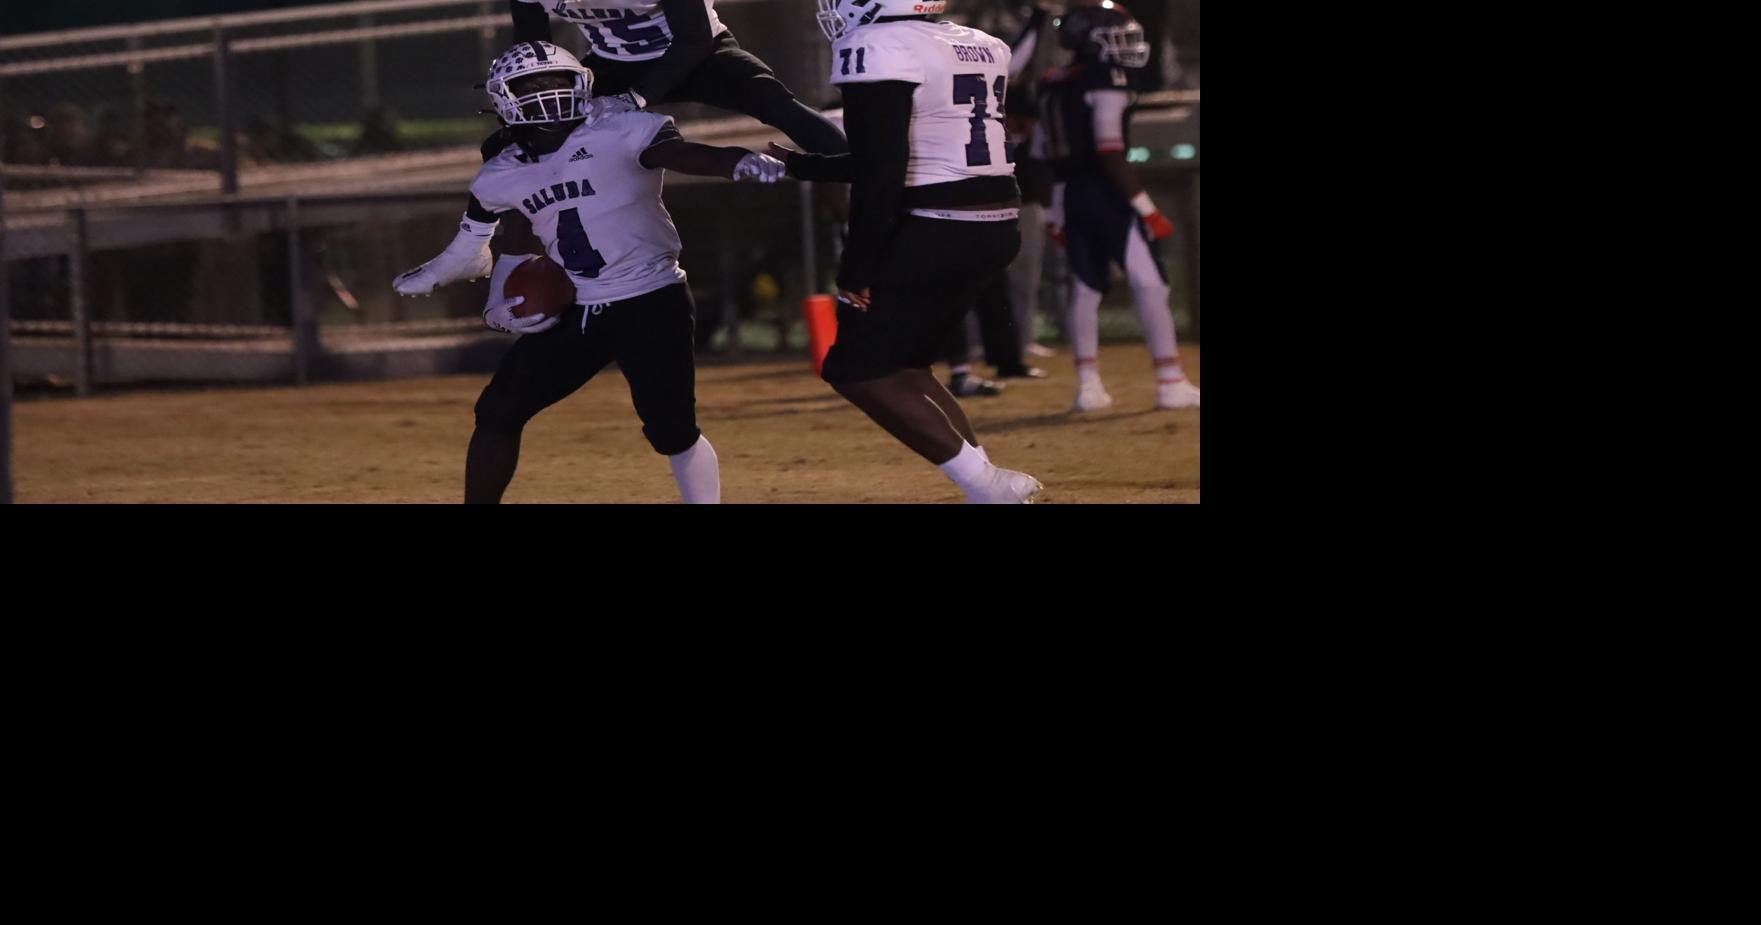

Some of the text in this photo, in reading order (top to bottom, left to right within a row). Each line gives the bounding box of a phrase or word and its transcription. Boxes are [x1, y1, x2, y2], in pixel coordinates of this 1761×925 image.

[583, 14, 670, 55] 15
[840, 47, 865, 75] 71
[953, 44, 995, 64] BROWN
[522, 179, 596, 214] SALUDA
[556, 207, 607, 278] 4
